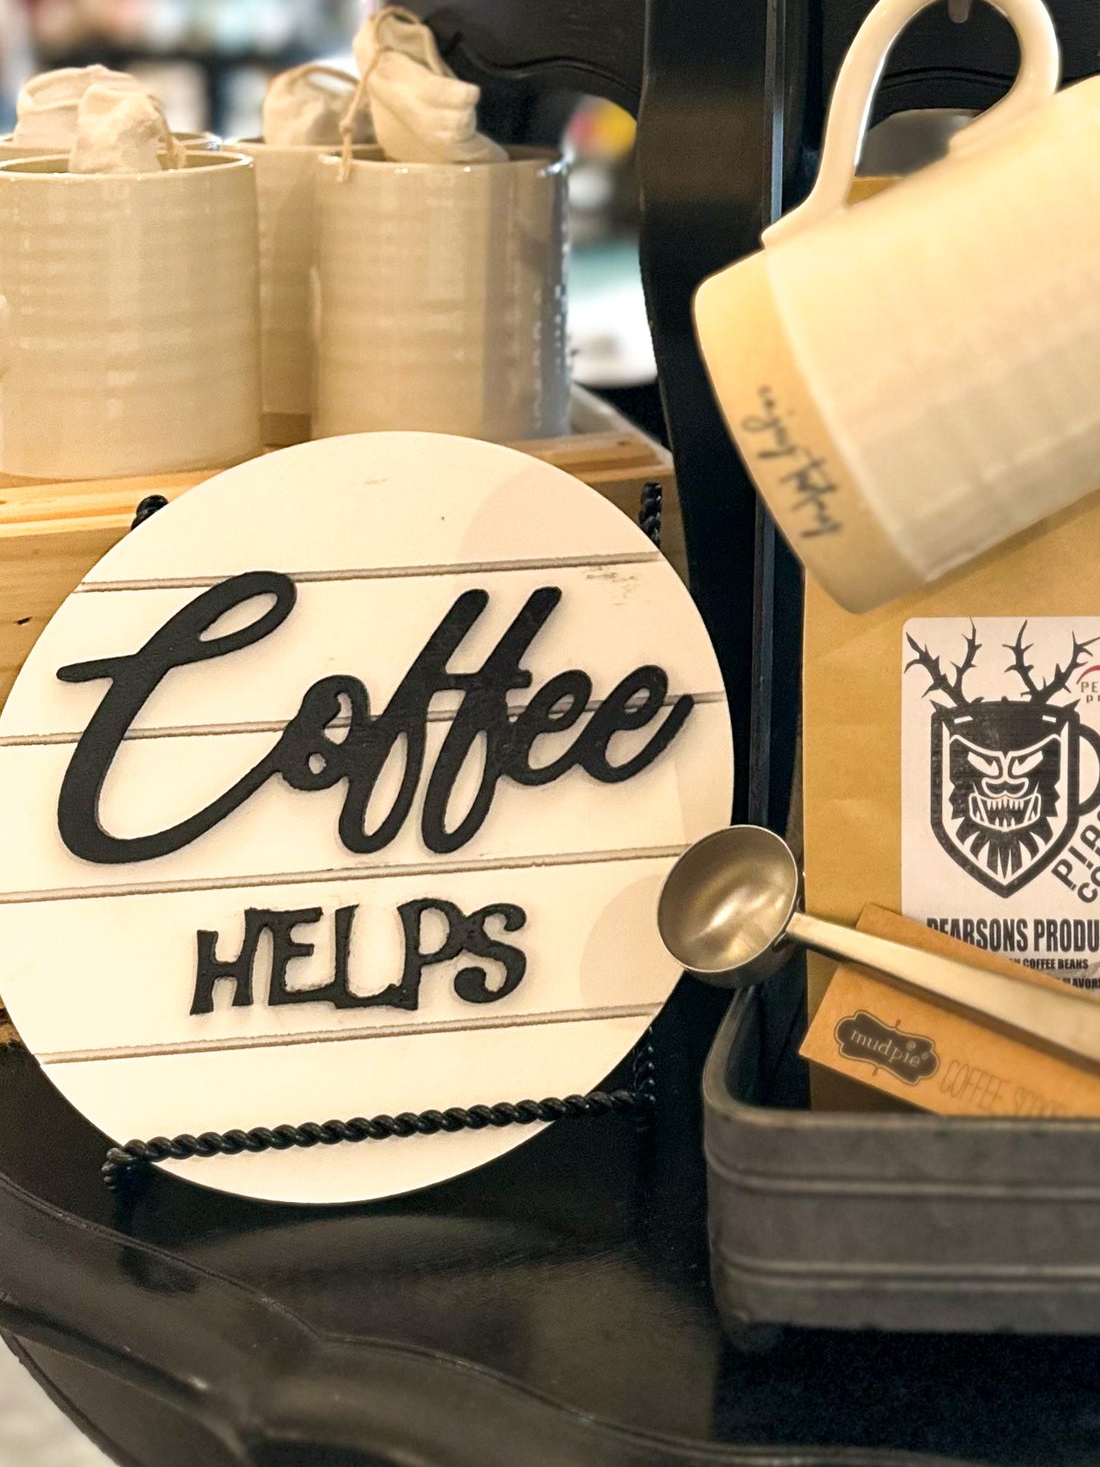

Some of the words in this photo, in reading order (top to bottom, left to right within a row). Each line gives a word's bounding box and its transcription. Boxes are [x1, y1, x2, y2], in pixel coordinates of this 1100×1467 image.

[56, 571, 695, 864] Coffee
[189, 897, 528, 1017] HELPS
[1057, 958, 1089, 970] BEANS
[850, 1029, 921, 1069] mudpie
[939, 1059, 1009, 1112] COFFEE
